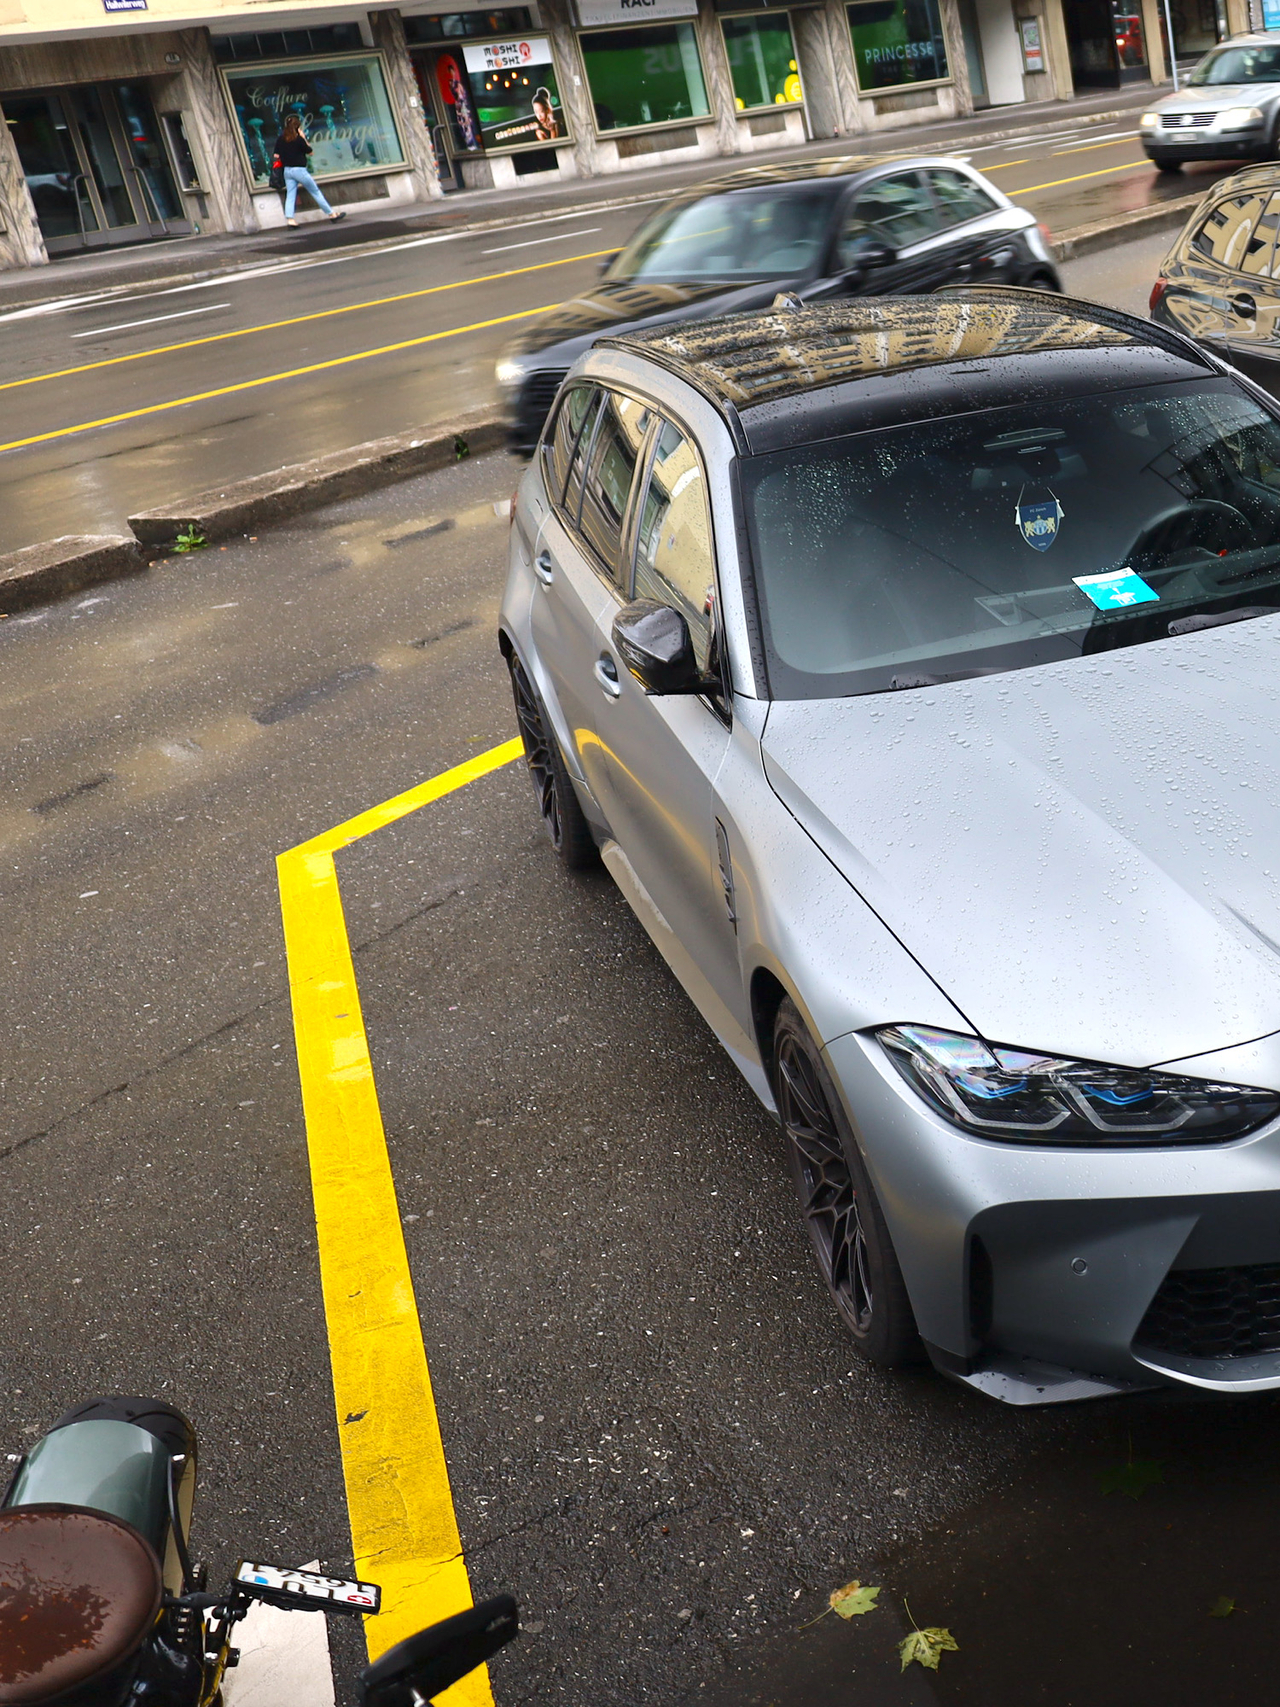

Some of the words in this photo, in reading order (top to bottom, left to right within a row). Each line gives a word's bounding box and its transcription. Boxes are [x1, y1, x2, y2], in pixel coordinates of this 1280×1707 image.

[483, 44, 518, 57] MOSHI
[864, 41, 934, 65] PRINCESSE
[486, 56, 521, 69] MOSHI
[246, 85, 308, 112] Coiffure
